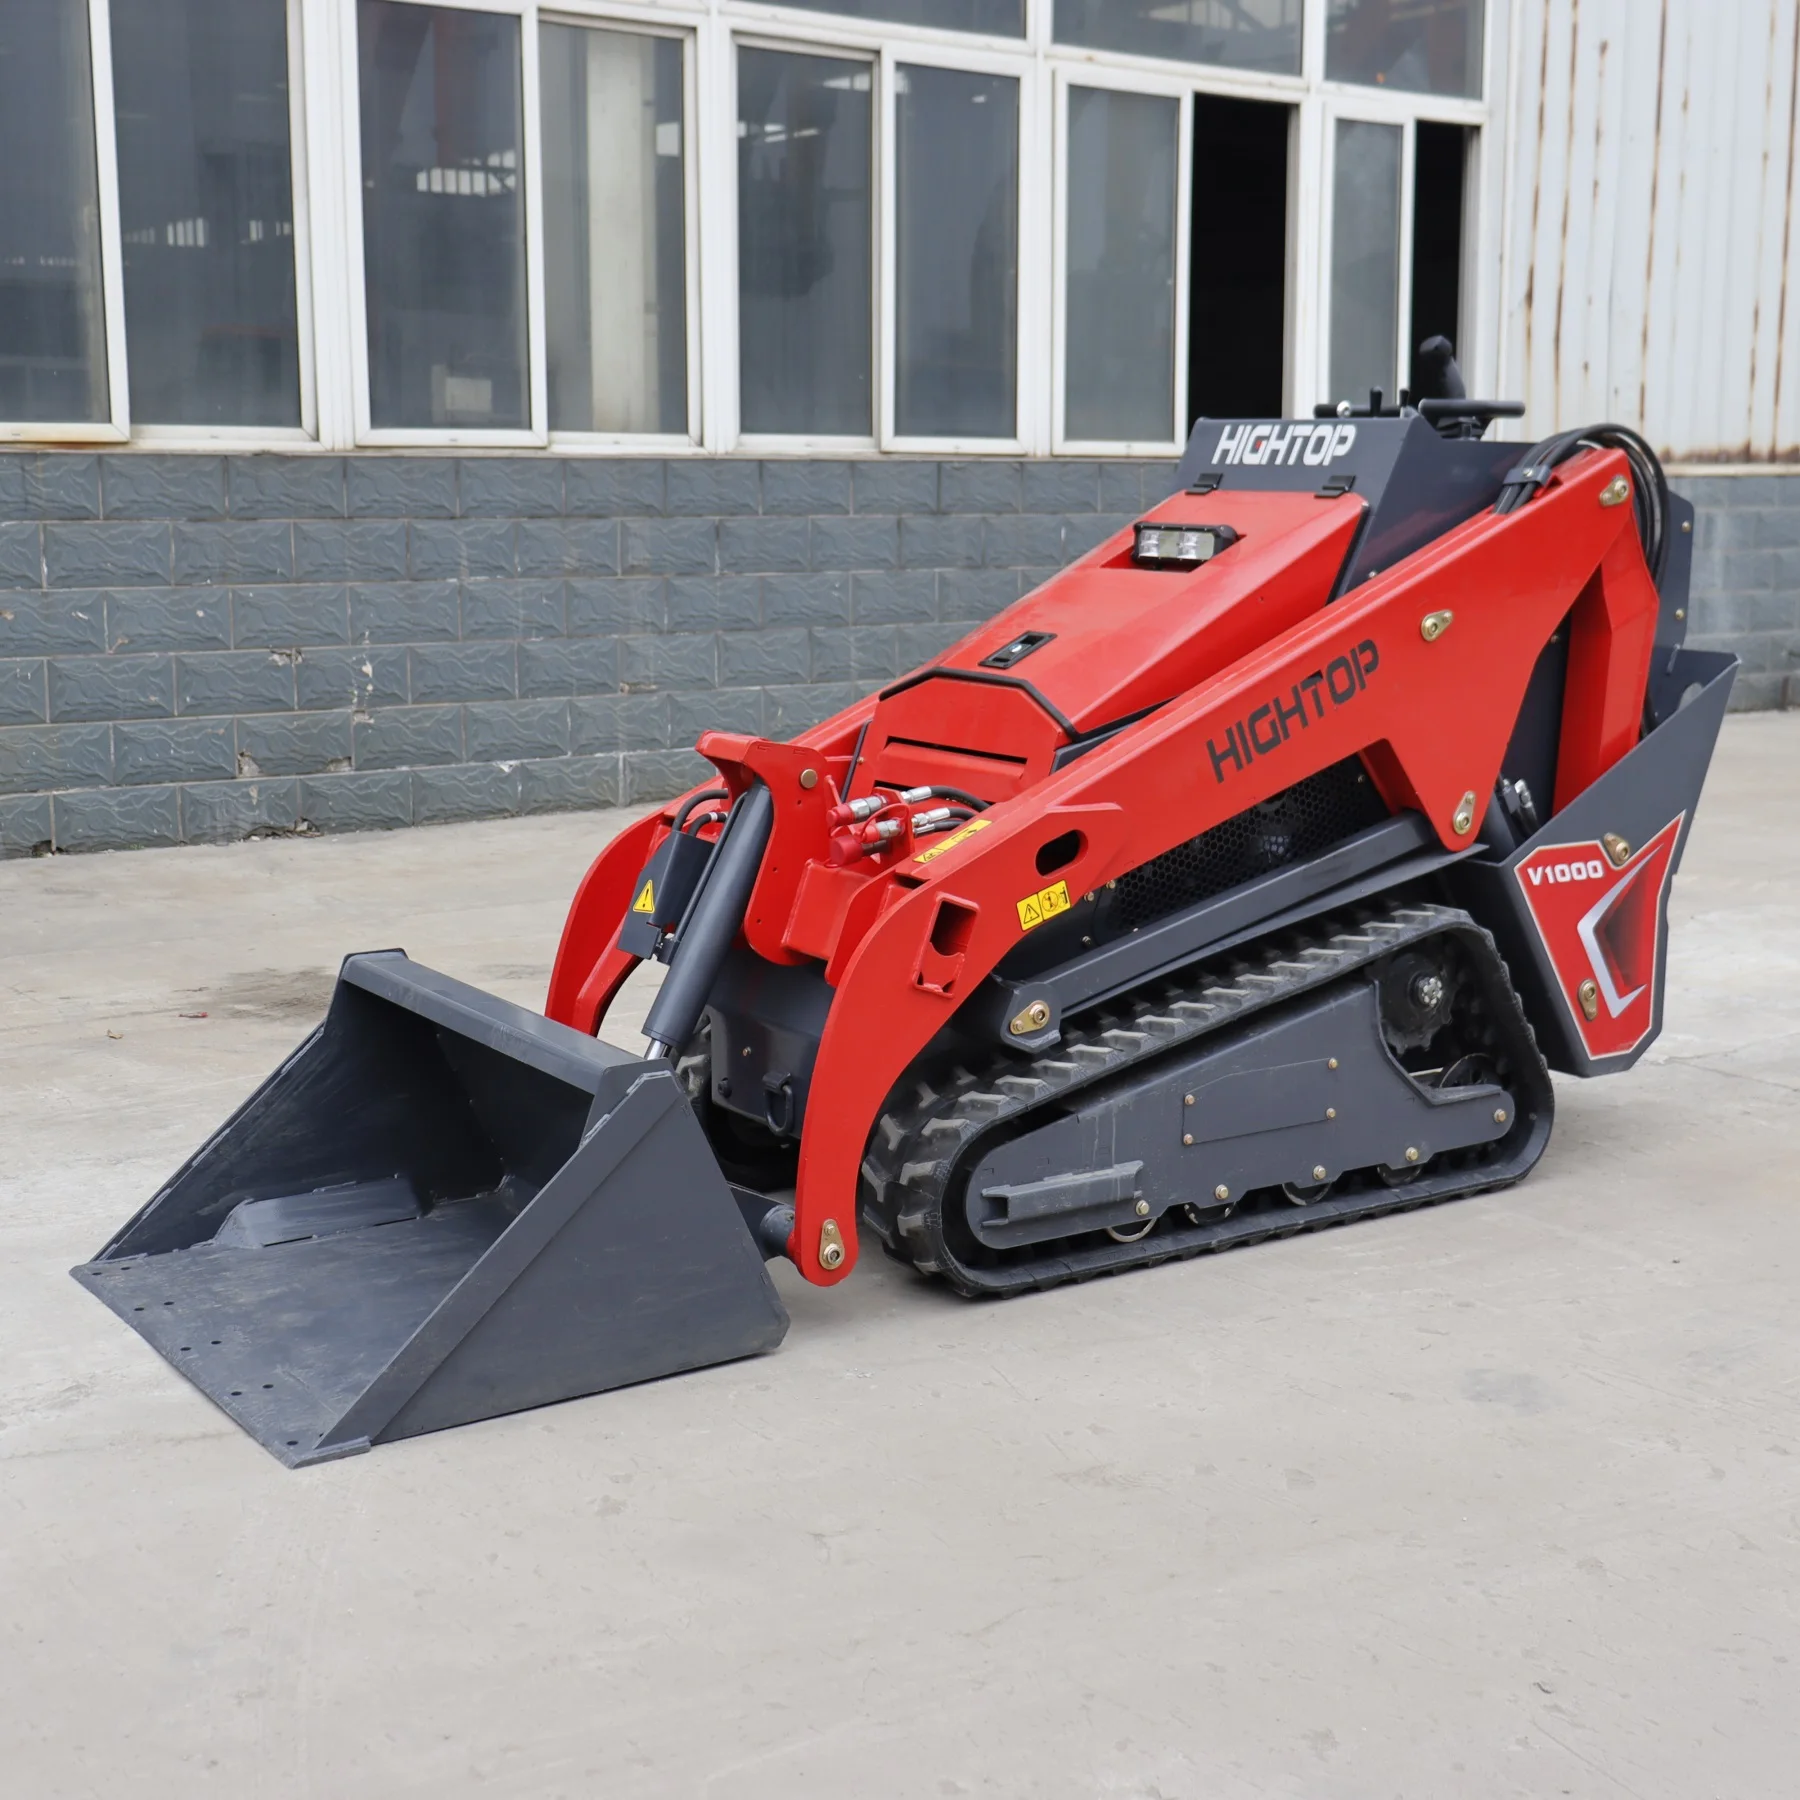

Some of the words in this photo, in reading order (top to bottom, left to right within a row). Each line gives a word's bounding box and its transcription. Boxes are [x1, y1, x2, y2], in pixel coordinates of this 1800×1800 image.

[1211, 424, 1356, 466] HIGHTOP
[1206, 639, 1379, 784] HIGHTOP
[1527, 860, 1604, 886] V1000
